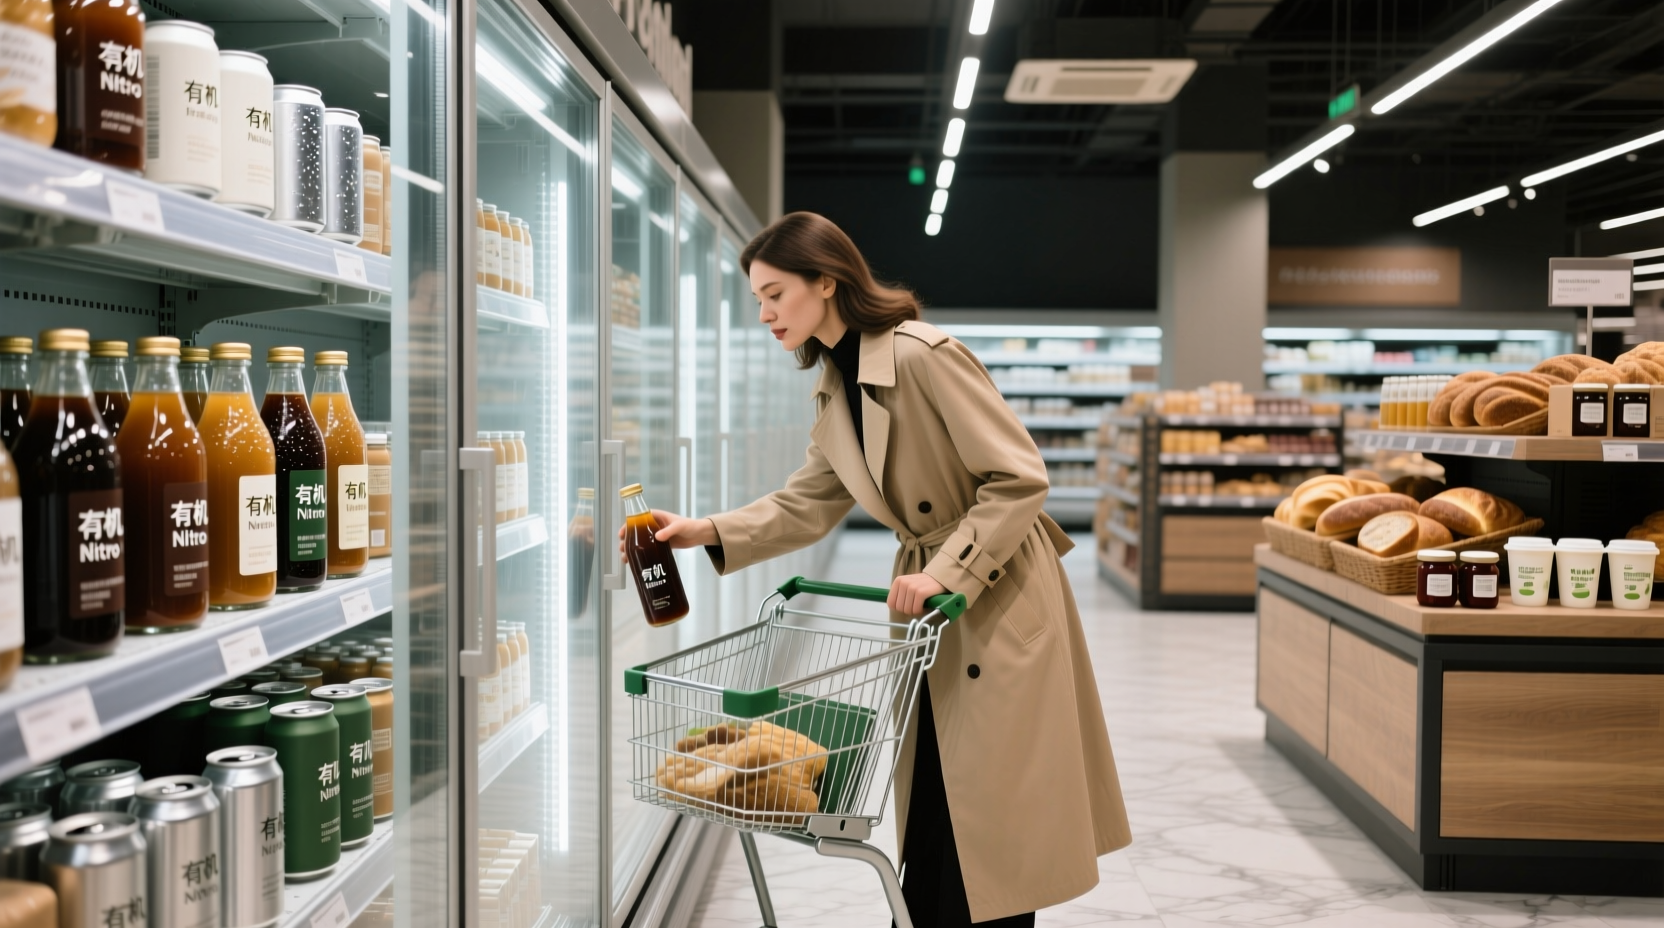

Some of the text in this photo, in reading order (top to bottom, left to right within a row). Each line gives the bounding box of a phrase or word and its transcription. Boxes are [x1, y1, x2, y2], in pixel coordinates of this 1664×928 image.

[98, 40, 144, 79] 有机
[184, 79, 218, 108] 有机
[246, 106, 272, 133] 有机
[246, 493, 276, 517] 有机
[295, 483, 326, 506] 有机
[78, 507, 124, 541] 有机
[170, 499, 208, 528] 有机
[79, 541, 121, 563] Nitro
[172, 529, 207, 548] Nitro
[181, 853, 218, 887] 有机
